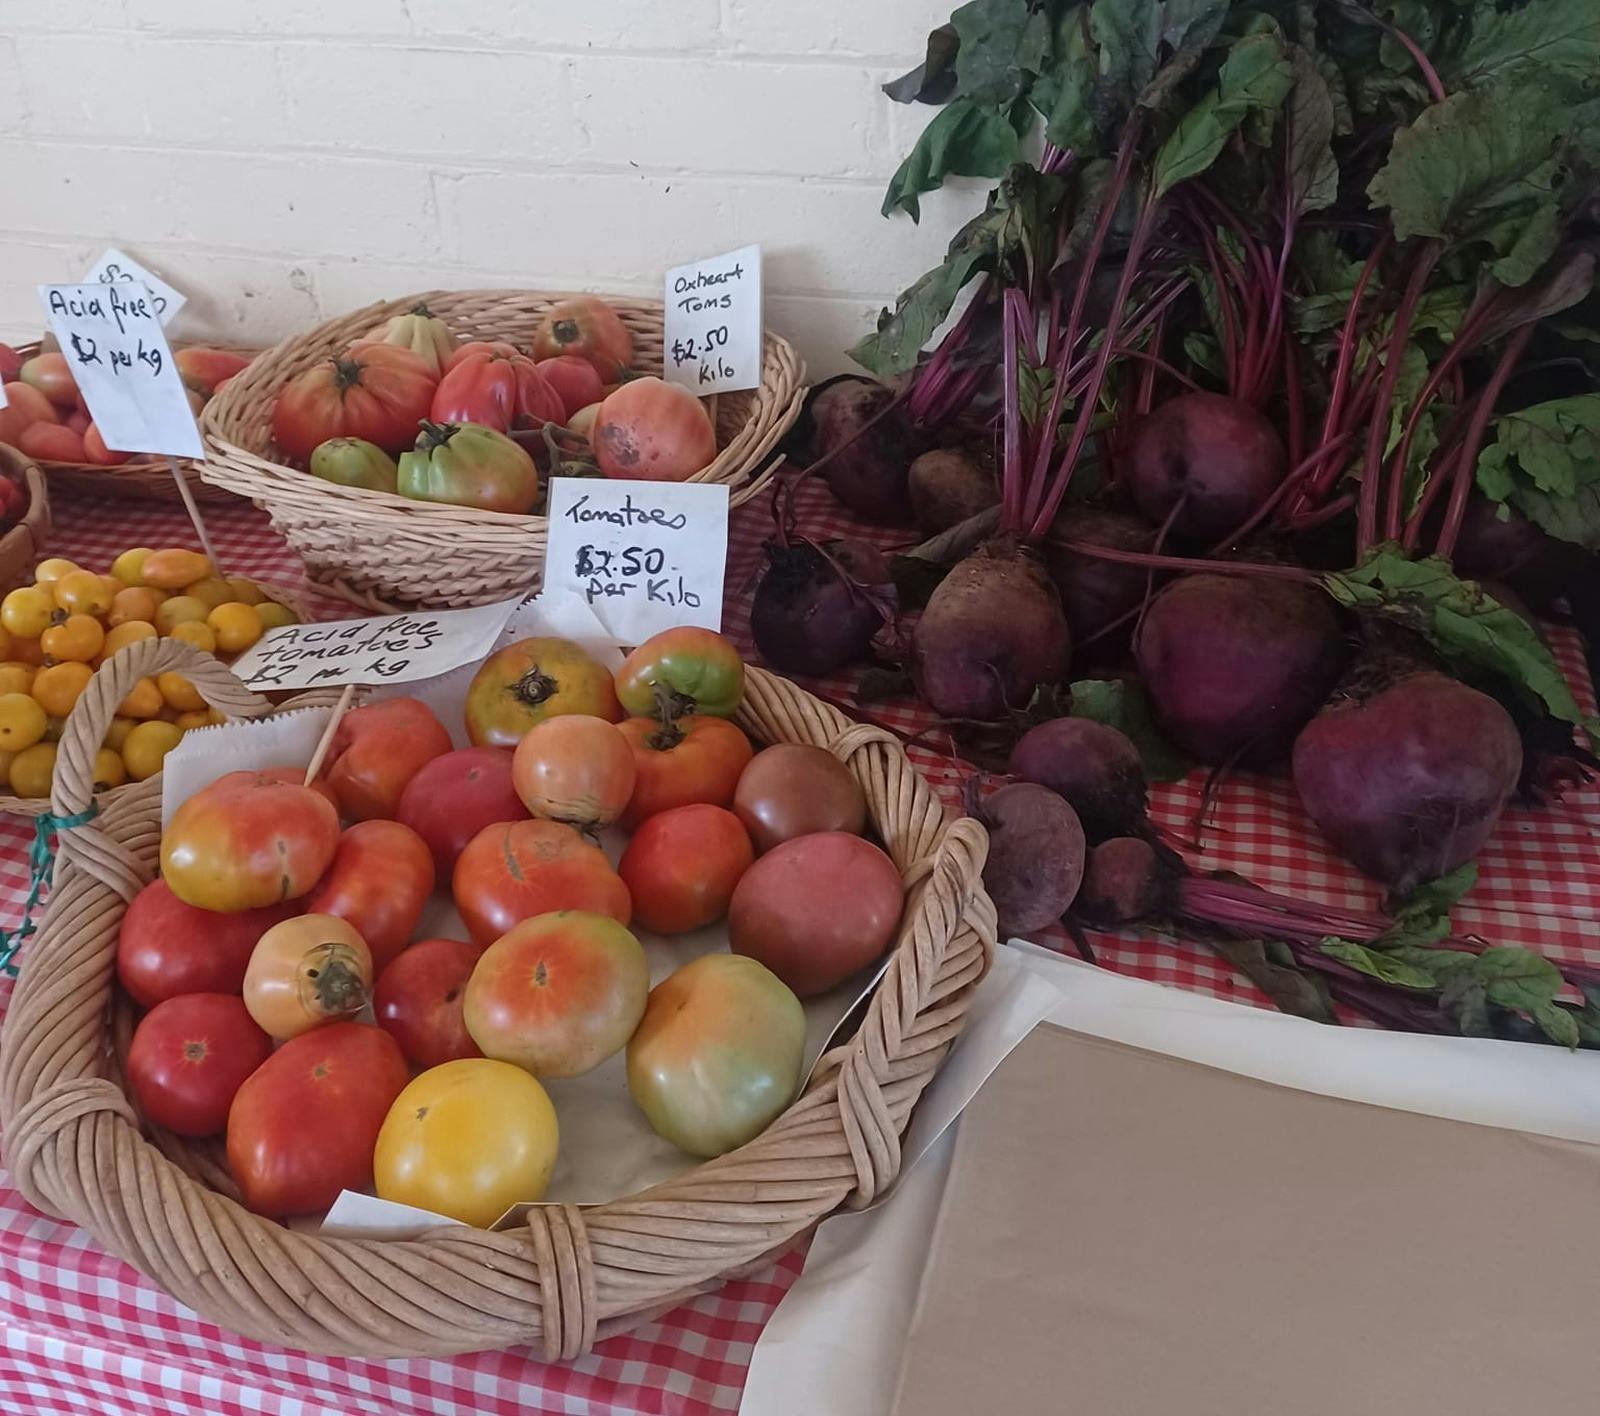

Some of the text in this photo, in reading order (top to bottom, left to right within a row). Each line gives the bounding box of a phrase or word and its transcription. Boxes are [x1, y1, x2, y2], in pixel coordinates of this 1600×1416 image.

[674, 263, 744, 293] Oxheart
[50, 289, 105, 318] Acid
[110, 286, 151, 334] free
[109, 350, 132, 376] per
[137, 338, 162, 377] kg
[671, 325, 729, 367] $2.50
[586, 576, 701, 607] per Kilo
[268, 615, 440, 644] Acid free
[256, 632, 443, 663] tomatoes
[364, 657, 411, 678] kg
